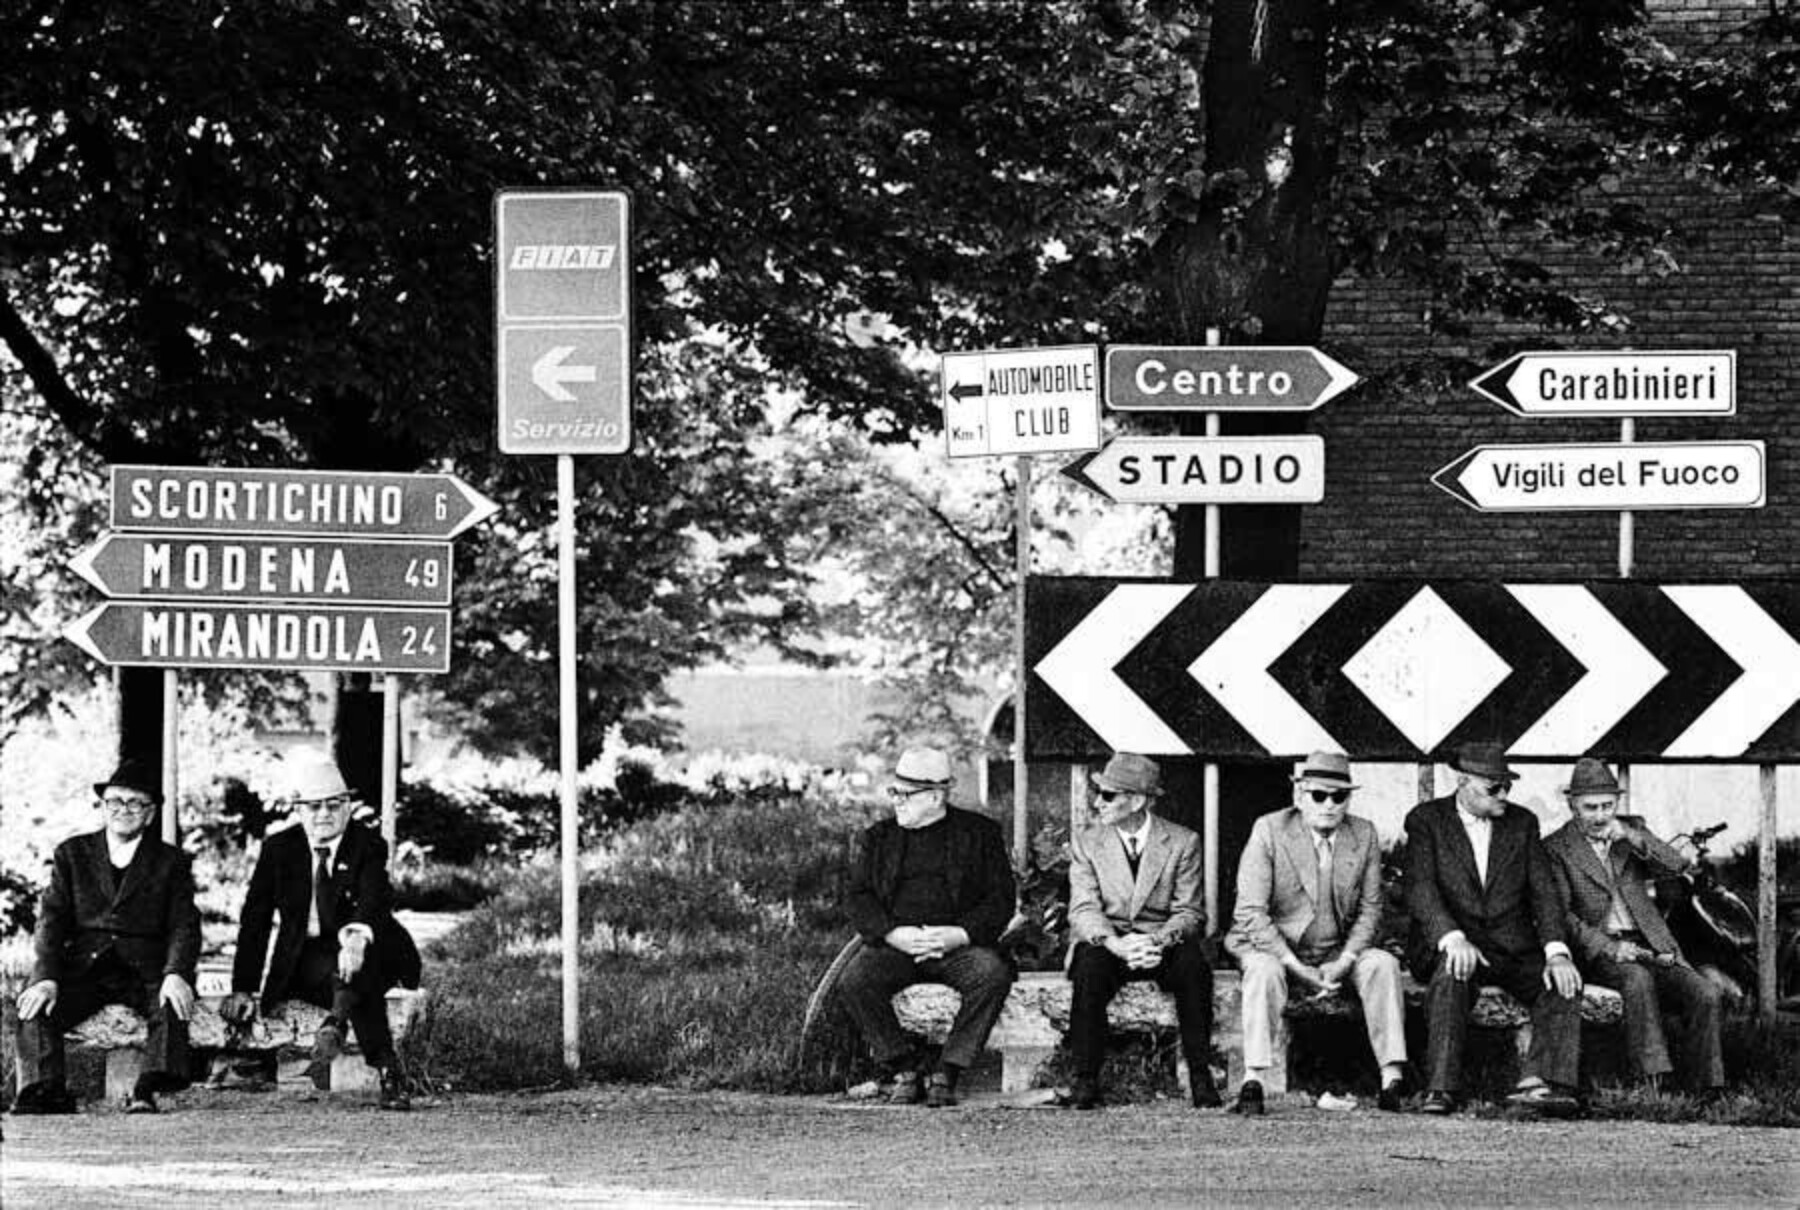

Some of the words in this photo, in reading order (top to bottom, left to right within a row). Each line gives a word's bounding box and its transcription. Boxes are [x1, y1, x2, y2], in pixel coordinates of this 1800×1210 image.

[509, 245, 615, 269] FIAT
[989, 363, 1093, 395] AUTOMOBILE
[1136, 360, 1292, 395] Centro
[1538, 367, 1716, 400] Carabinieri
[511, 418, 619, 440] Servizio
[1014, 408, 1069, 437] CLUB
[1119, 454, 1301, 485] STADIO
[1493, 459, 1565, 491] Vigili
[1578, 459, 1626, 487] del
[1639, 459, 1740, 487] Fuoco
[132, 479, 402, 524] SCORTICHINO
[434, 492, 448, 521] 6
[143, 544, 351, 593] MODENA
[405, 557, 440, 590] 49
[141, 611, 381, 662] MIRANDOLA
[401, 625, 438, 656] 24
